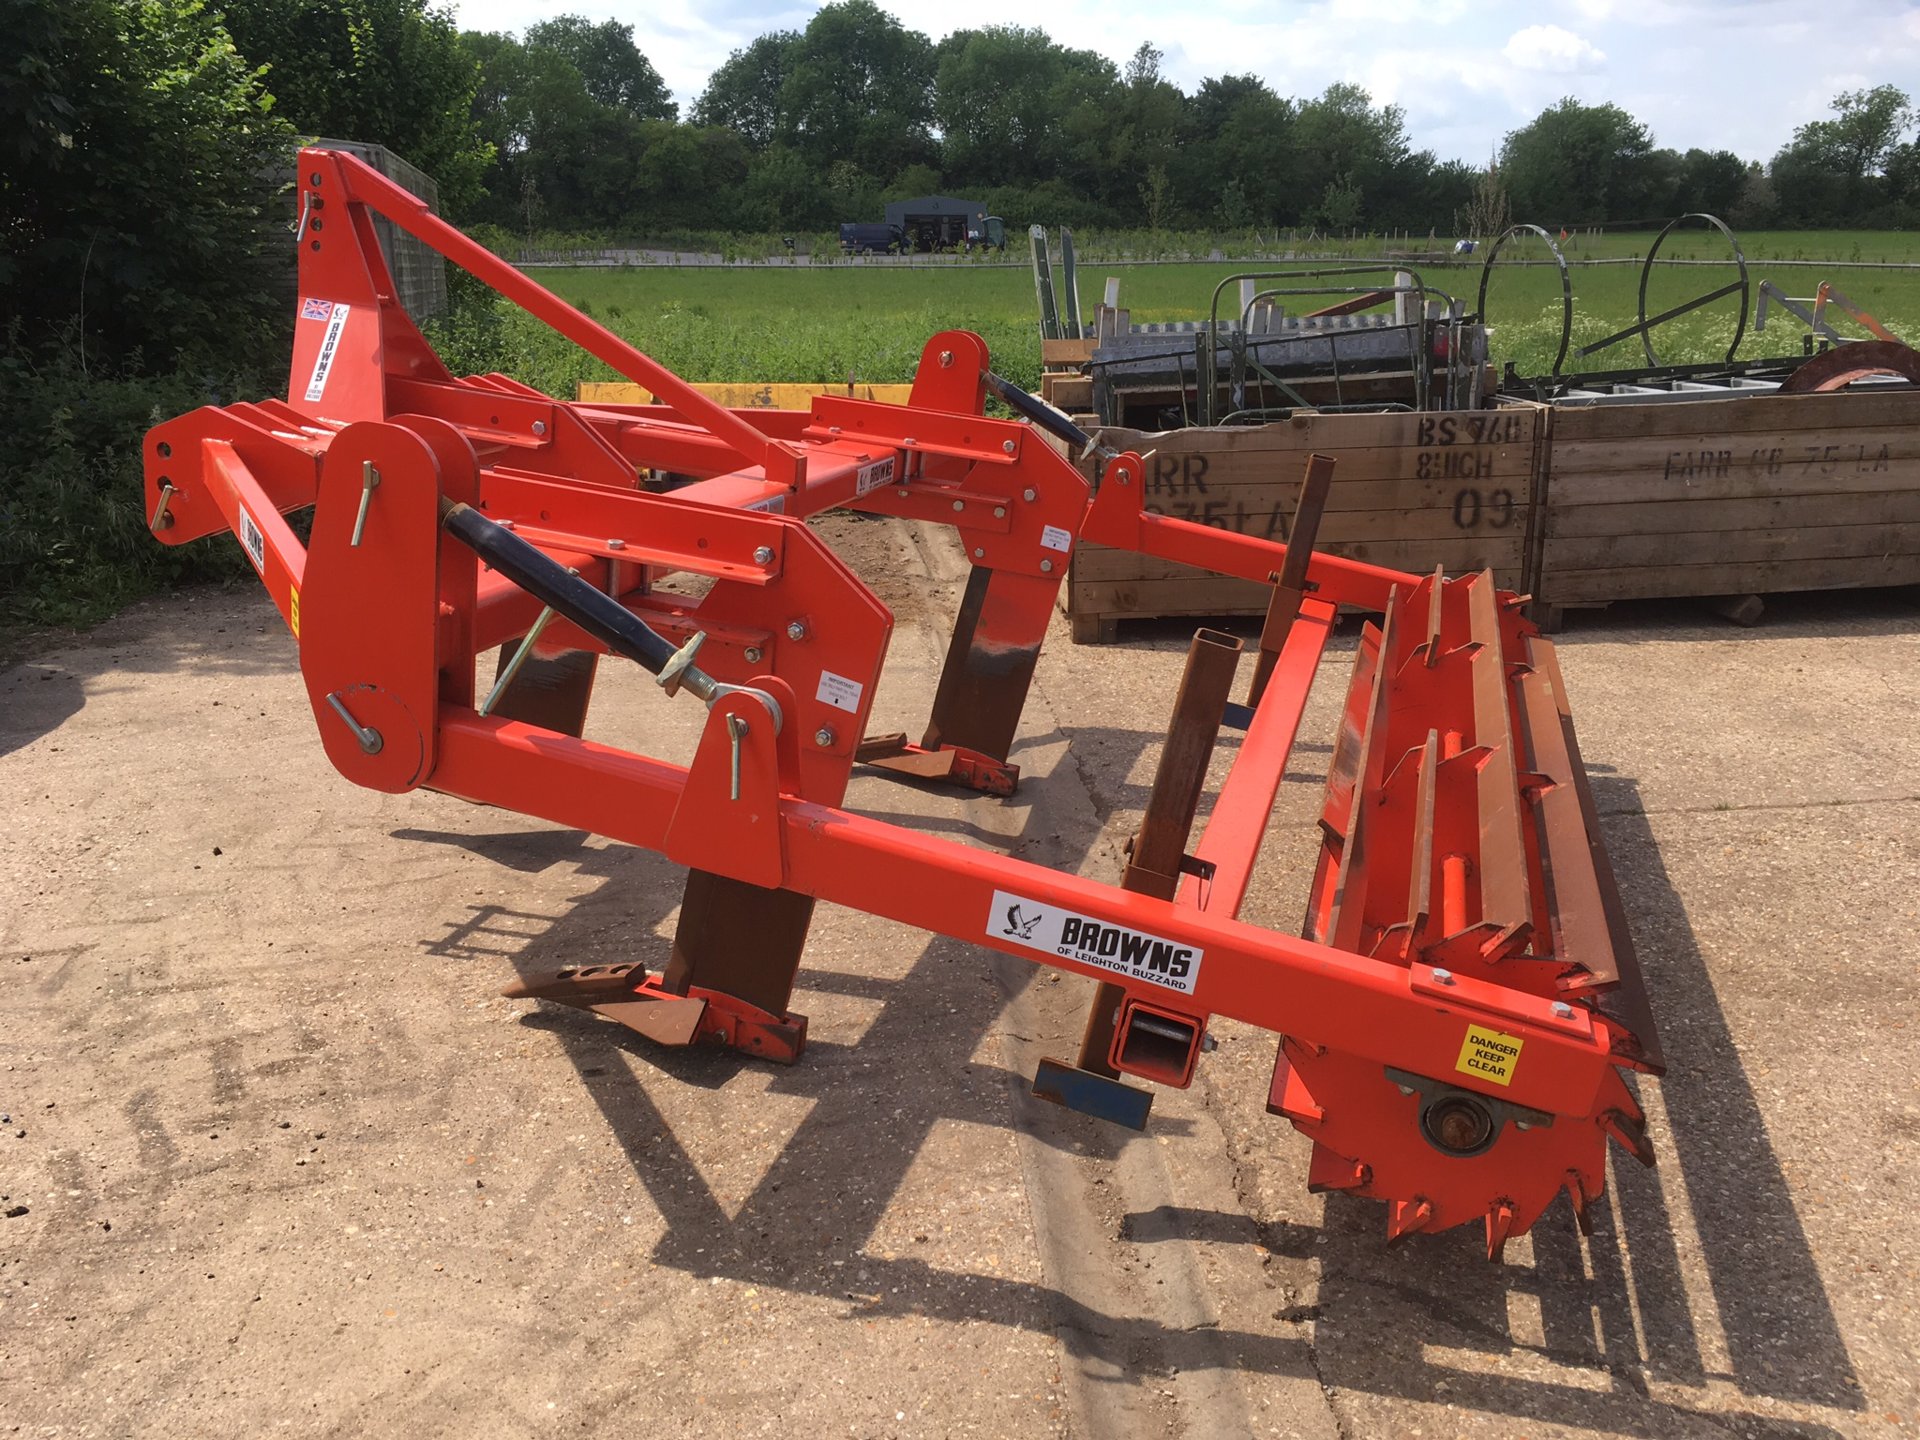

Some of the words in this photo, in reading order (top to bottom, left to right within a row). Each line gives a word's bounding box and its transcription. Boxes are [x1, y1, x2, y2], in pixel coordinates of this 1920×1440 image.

[1060, 917, 1192, 978] BROWNS
[1057, 946, 1072, 956] OF
[1074, 951, 1129, 973] LEIGHTON
[1132, 968, 1187, 990] BUZZARD
[1469, 1035, 1518, 1057] DANGER
[1475, 1049, 1505, 1063] KEEP
[1467, 1058, 1506, 1077] CLEAR
